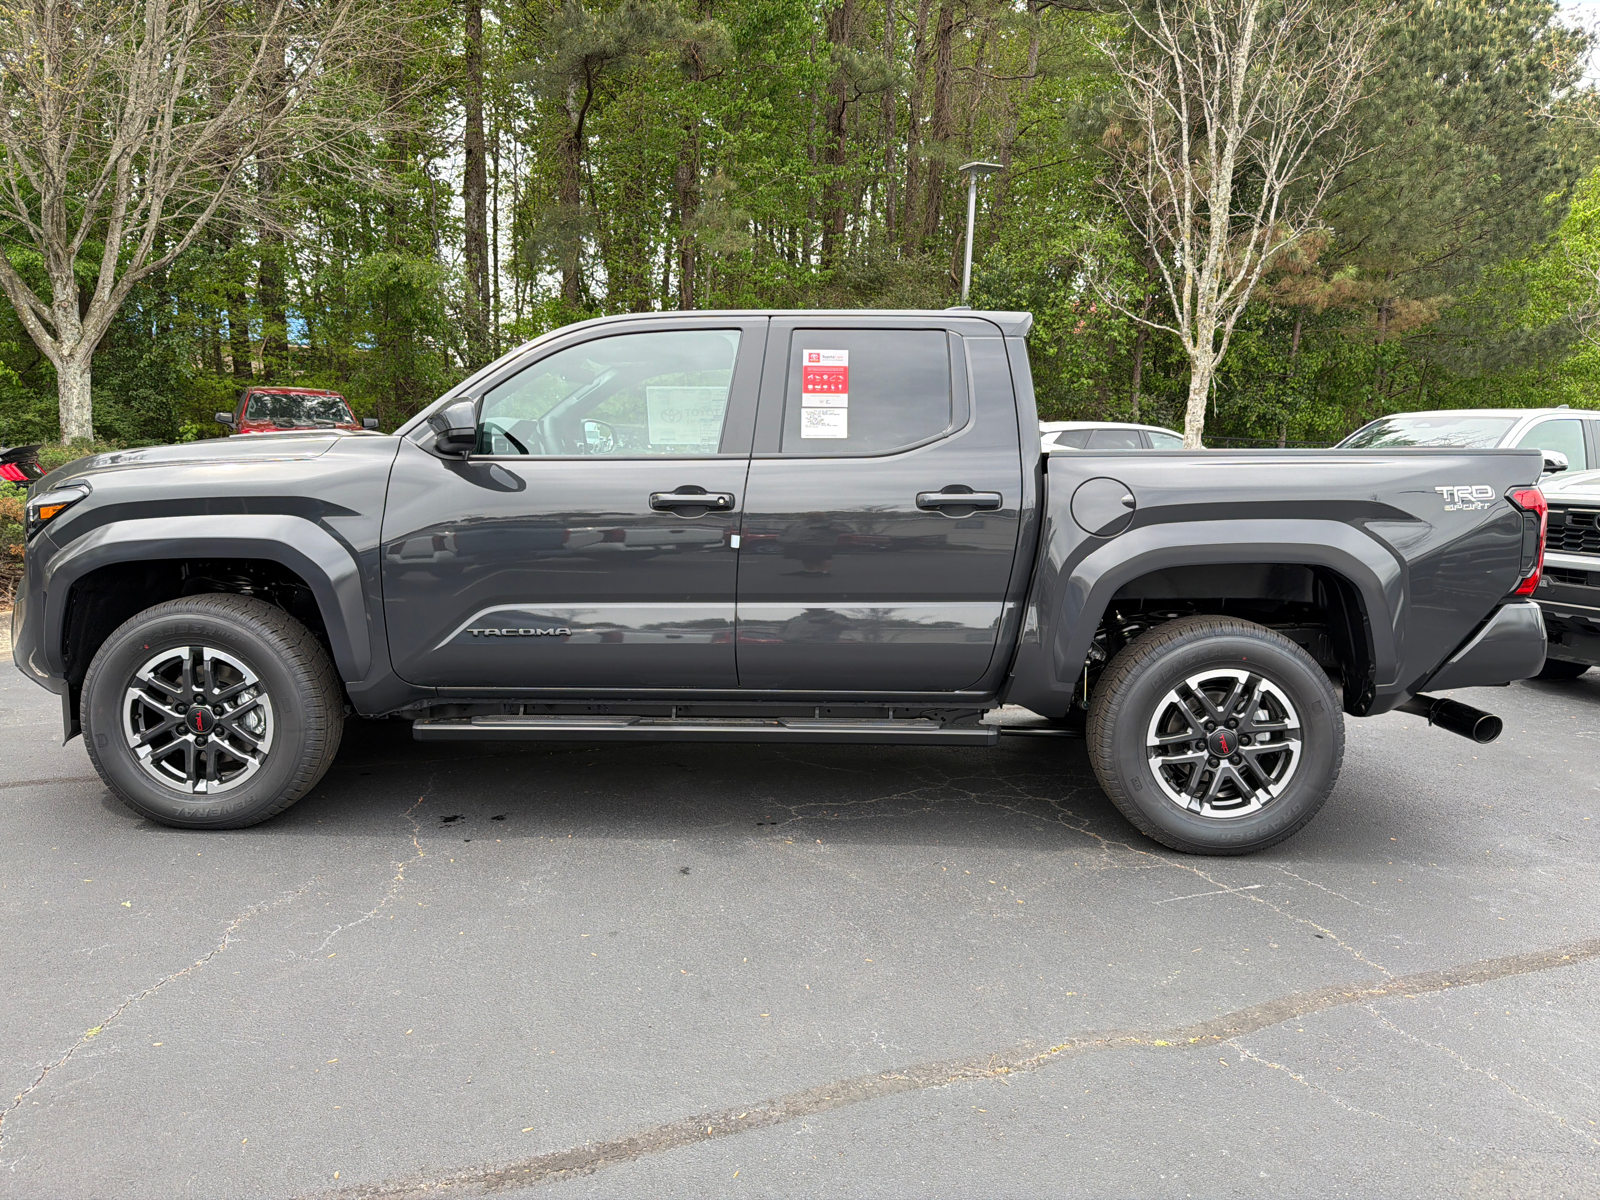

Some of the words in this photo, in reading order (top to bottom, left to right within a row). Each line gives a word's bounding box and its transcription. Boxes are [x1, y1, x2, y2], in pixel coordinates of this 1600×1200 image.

[1434, 485, 1496, 502] TRD
[1443, 502, 1491, 511] SPORT
[466, 628, 572, 637] TACOMA
[195, 710, 204, 731] TRD
[1219, 734, 1229, 753] TRD
[172, 793, 259, 818] GENERAL
